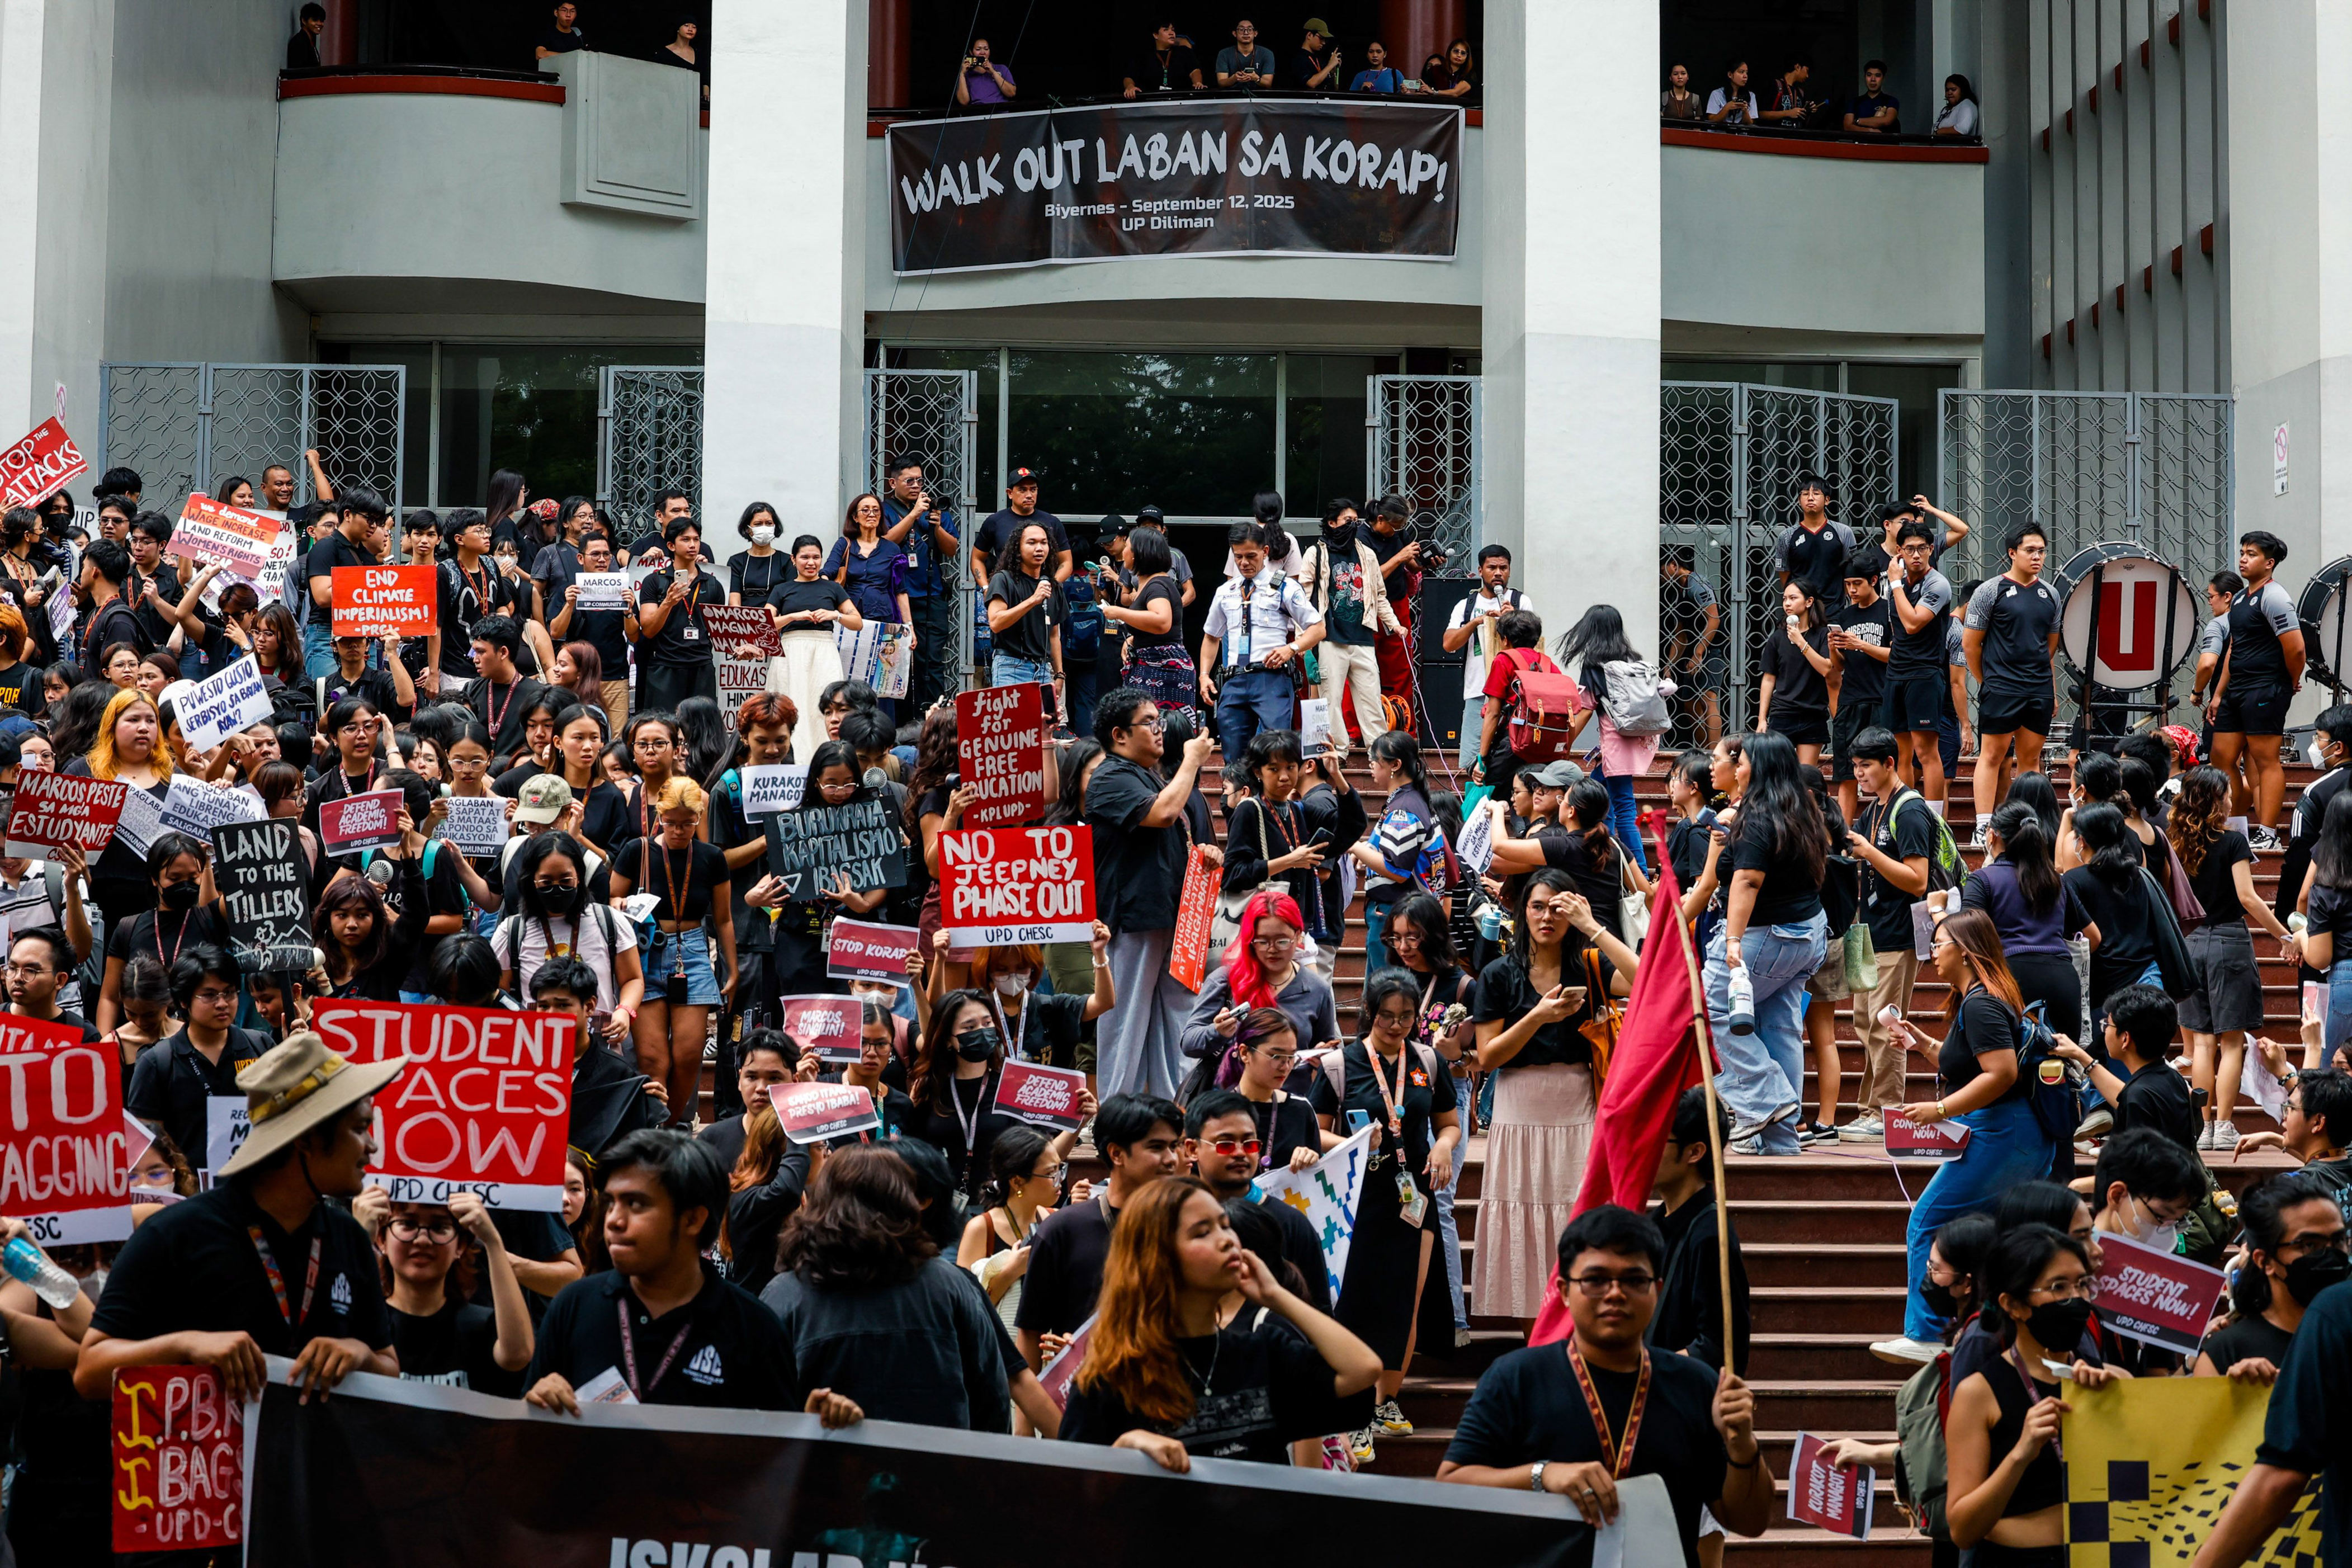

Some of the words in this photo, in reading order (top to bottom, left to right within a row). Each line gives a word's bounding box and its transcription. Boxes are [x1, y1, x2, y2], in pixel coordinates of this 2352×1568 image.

[901, 151, 1005, 215] WALK
[1013, 138, 1086, 193] OUT
[1097, 130, 1227, 184] LABAN
[1238, 129, 1292, 179] SA
[1302, 134, 1448, 203] KORAP!
[1045, 200, 1116, 219] Biyernes
[1131, 196, 1225, 216] September
[1229, 196, 1250, 211] 12,
[1254, 195, 1295, 210] 2025
[1121, 217, 1145, 232] UP
[1150, 215, 1213, 230] Diliman
[0, 439, 34, 487] TOP
[33, 428, 49, 441] THE
[6, 440, 83, 504] ATTACKS
[200, 502, 216, 513] we
[182, 519, 211, 536] LAND
[213, 530, 253, 550] REFORM
[187, 506, 219, 526] WAGE
[221, 518, 267, 541] INCREASE
[177, 531, 228, 555] WOMEN'S
[229, 548, 261, 565] RIGHTS
[366, 570, 399, 588] END
[352, 588, 414, 604] CLIMATE
[334, 604, 429, 623] IMPERIALISM!
[712, 607, 767, 622] MARCOS
[2098, 581, 2157, 672] U
[180, 677, 223, 713] PUWESTO
[224, 660, 255, 689] GUSTO,
[719, 664, 769, 687] EDUKAS
[186, 700, 226, 733] SERBISYO
[228, 693, 241, 709] SA
[239, 678, 263, 701] BAYAN
[972, 689, 1021, 720] fight
[981, 715, 1012, 734] for
[960, 728, 1039, 759] GENUINE
[975, 752, 1018, 778] FREE
[753, 776, 808, 790] KURAKOT
[961, 769, 1042, 800] EDUCATION
[87, 782, 125, 809] PESTE
[173, 783, 199, 797] ANG
[202, 791, 238, 814] TUNAY
[241, 807, 257, 821] NA
[343, 799, 380, 814] DEFEND
[448, 799, 494, 807] AGLABAN
[749, 790, 805, 803] MANAGOT
[39, 801, 55, 813] SA
[59, 803, 91, 817] MGA
[172, 802, 229, 826] EDUKASY
[188, 799, 235, 822] LIBRENG
[339, 807, 386, 825] ACADEMIC
[457, 816, 497, 825] MATAAS
[10, 811, 115, 847] ESTUDYANTE
[116, 824, 149, 853] OMMUNITY
[338, 817, 388, 836] FREEDOM!
[433, 831, 496, 842] EDUKASYON!
[448, 824, 484, 833] PONDO
[219, 824, 291, 863] LAND
[351, 839, 362, 847] UPD
[363, 837, 379, 846] CHESC
[459, 845, 495, 854] MMUNITY
[783, 827, 897, 872] KAPITALISMO
[943, 830, 995, 865] NO
[1025, 826, 1073, 859] TO
[1472, 820, 1491, 858] ESTUDYANT
[235, 867, 257, 884] TO
[262, 862, 296, 882] THE
[955, 857, 1078, 885] JEEPNEY
[1182, 849, 1198, 907] TRABAHO
[226, 887, 304, 924] TILLERS
[953, 881, 1035, 919] PHASE
[1037, 880, 1085, 918] OUT
[1178, 957, 1186, 976] AT
[1183, 863, 1202, 948] KARAPATAN
[1188, 870, 1210, 961] IPAGLABAN
[985, 929, 1013, 943] UPD
[1019, 927, 1053, 941] CHESC
[1208, 938, 1226, 948] BAI
[833, 938, 864, 954] STOP
[865, 944, 908, 960] KORAP
[800, 1010, 843, 1023] MARCOS
[318, 1009, 576, 1069] STUDENT
[797, 1022, 846, 1037] SINGILIN!
[0, 1047, 108, 1132] TO
[390, 1066, 567, 1117] ACES
[1017, 1084, 1071, 1101] ACADEMIC
[1026, 1074, 1069, 1090] DEFEND
[1014, 1093, 1070, 1112] FREEDOM!
[816, 1124, 829, 1133] UPD
[830, 1120, 848, 1130] CHESC
[1913, 1129, 1941, 1140] NOW!
[2118, 1265, 2189, 1298] STUDENT
[2099, 1275, 2155, 1305] SPACES
[2153, 1295, 2200, 1320] NOW!
[2115, 1315, 2133, 1328] UPD
[2133, 1320, 2160, 1335] CHESC
[1808, 1460, 1826, 1514] KURAKOT
[1855, 1497, 1865, 1509] UPD
